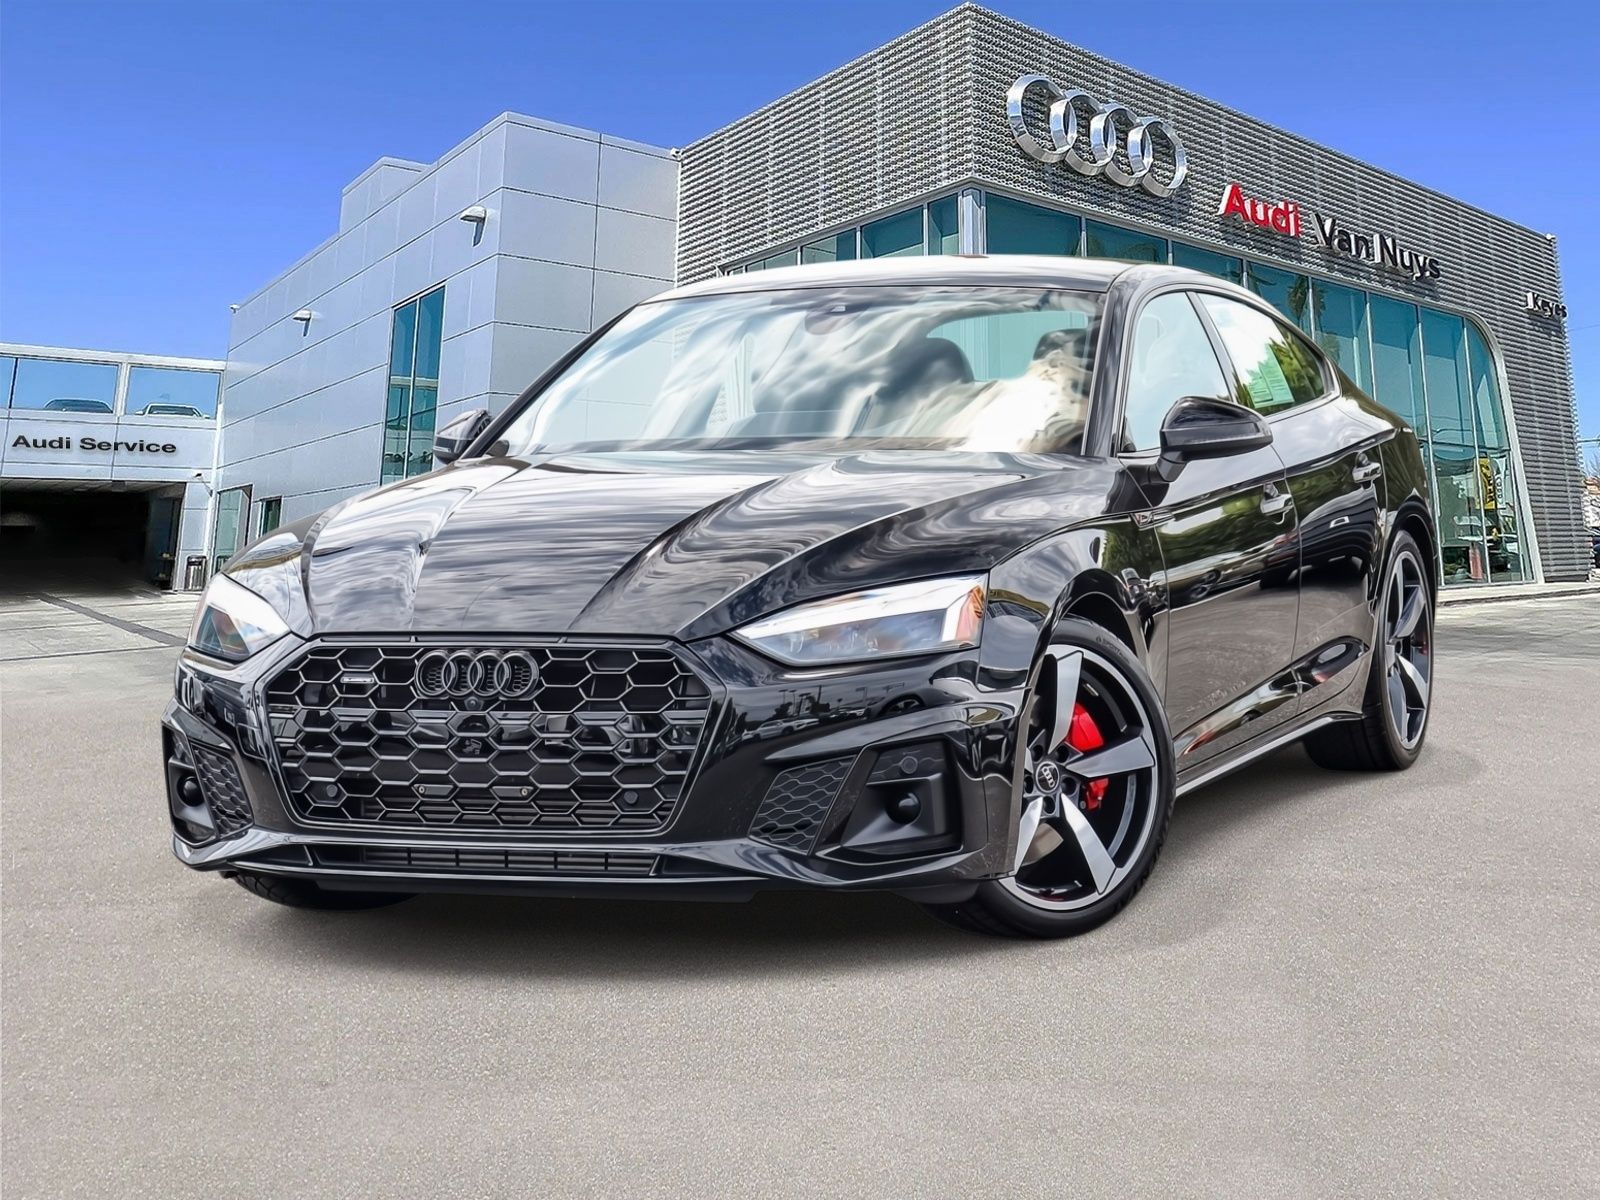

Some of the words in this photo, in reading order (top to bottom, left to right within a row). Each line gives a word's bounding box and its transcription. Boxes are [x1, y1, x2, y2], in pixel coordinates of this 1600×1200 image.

[1217, 183, 1301, 238] Audi
[1310, 213, 1371, 259] Van
[1373, 233, 1441, 280] Nuys
[1527, 292, 1568, 318] Keyes
[12, 435, 71, 449] Audi
[79, 437, 177, 454] Service
